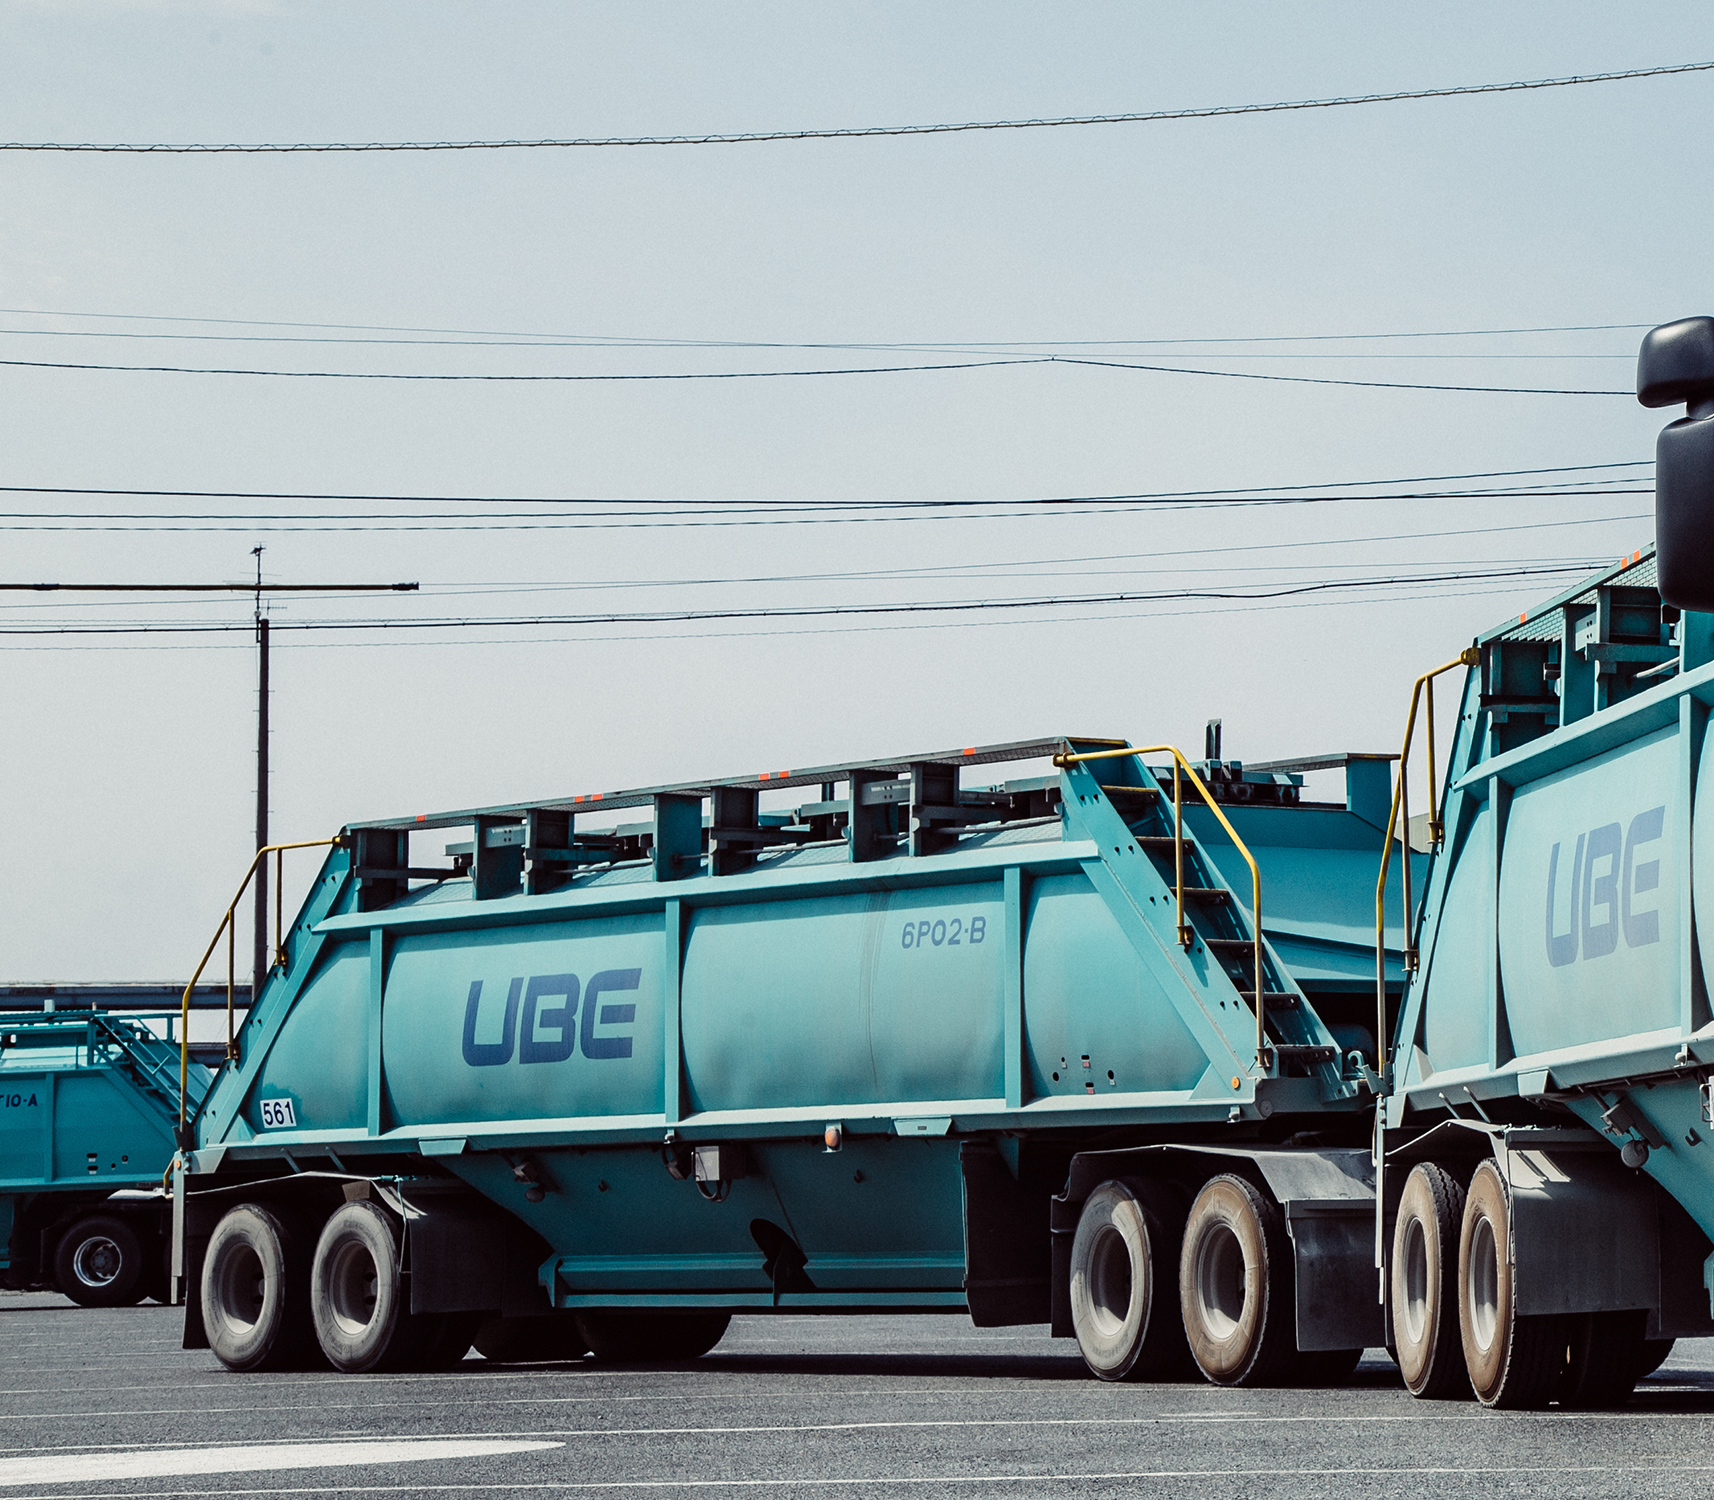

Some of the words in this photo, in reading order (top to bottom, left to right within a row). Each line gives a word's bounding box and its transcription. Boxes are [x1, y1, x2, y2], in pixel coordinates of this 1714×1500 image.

[1546, 806, 1666, 968] UBE
[461, 967, 642, 1066] UBE
[263, 1101, 294, 1126] 561
